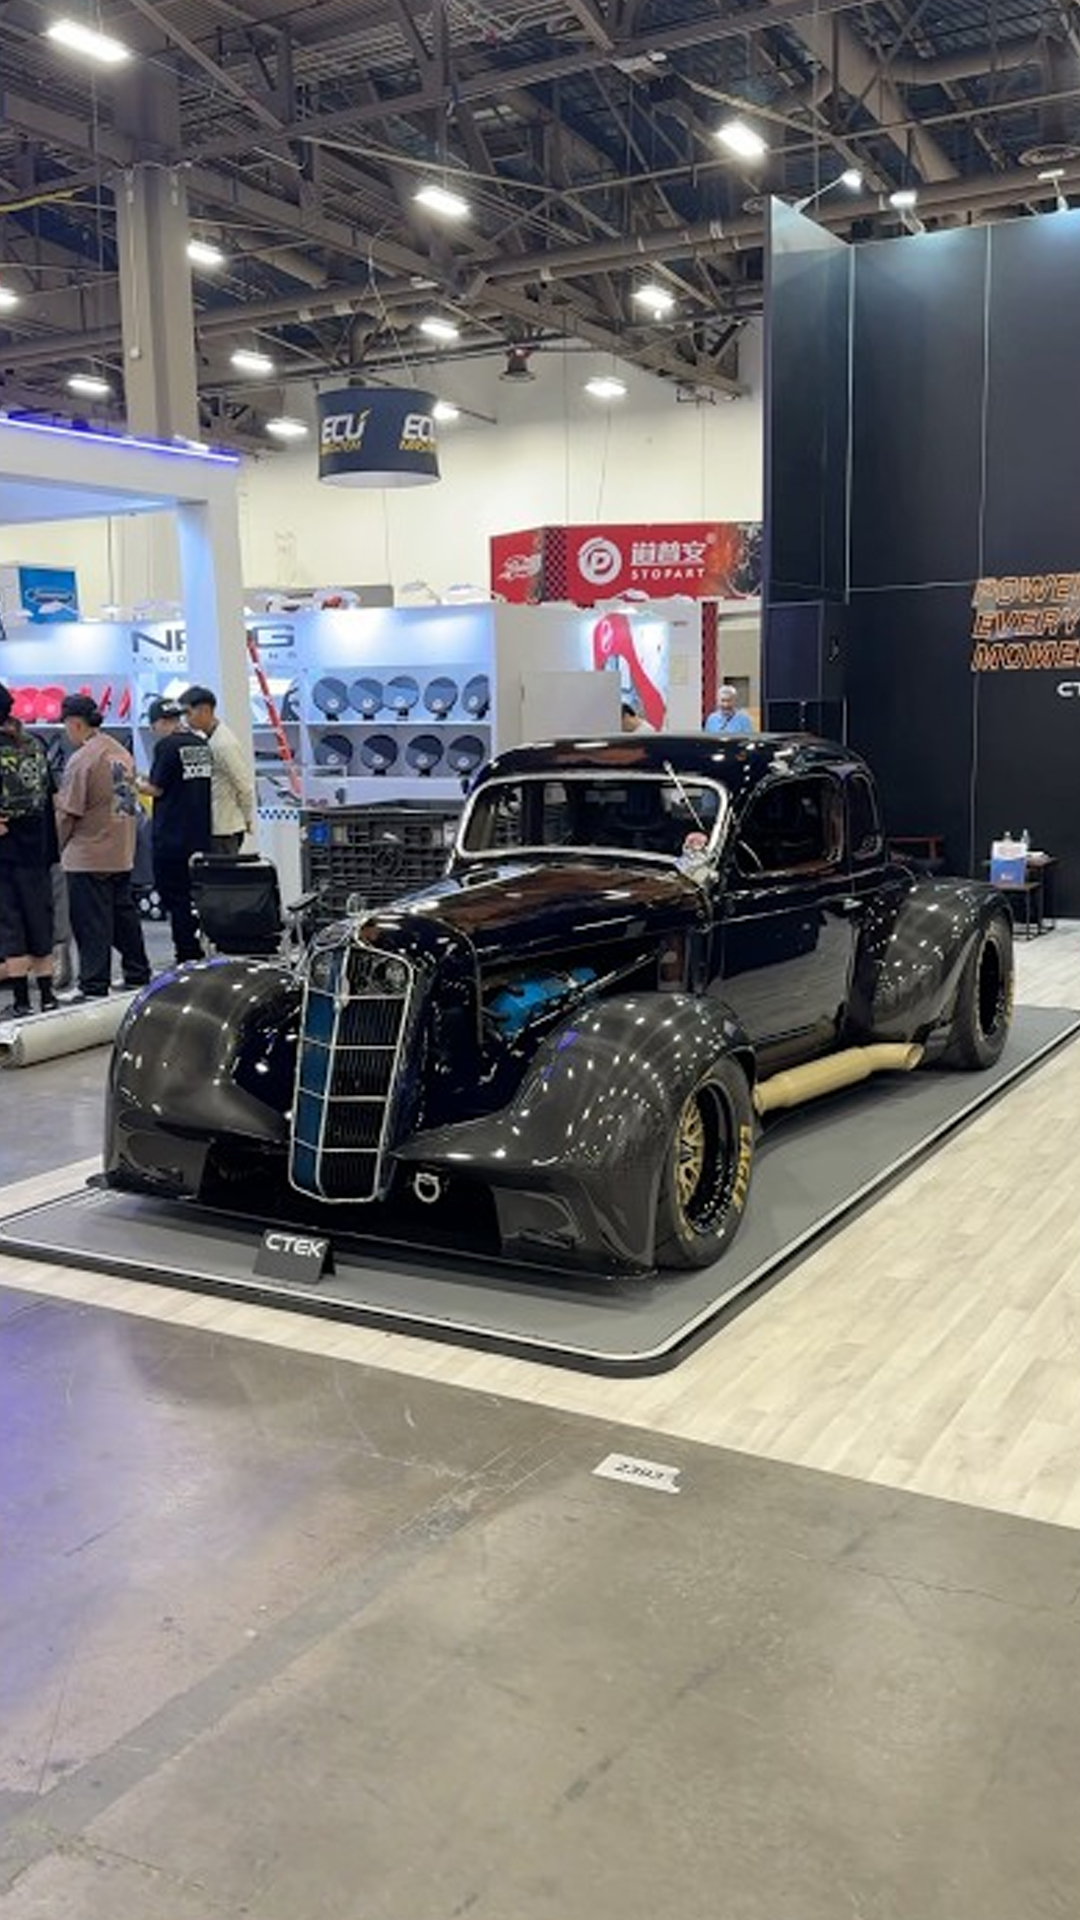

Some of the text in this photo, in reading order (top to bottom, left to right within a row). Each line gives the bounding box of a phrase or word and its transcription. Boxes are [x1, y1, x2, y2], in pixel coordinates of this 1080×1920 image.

[321, 409, 370, 444] ECU
[631, 568, 706, 581] STOPART
[970, 640, 1080, 672] MOME
[265, 1233, 324, 1258] CTEK
